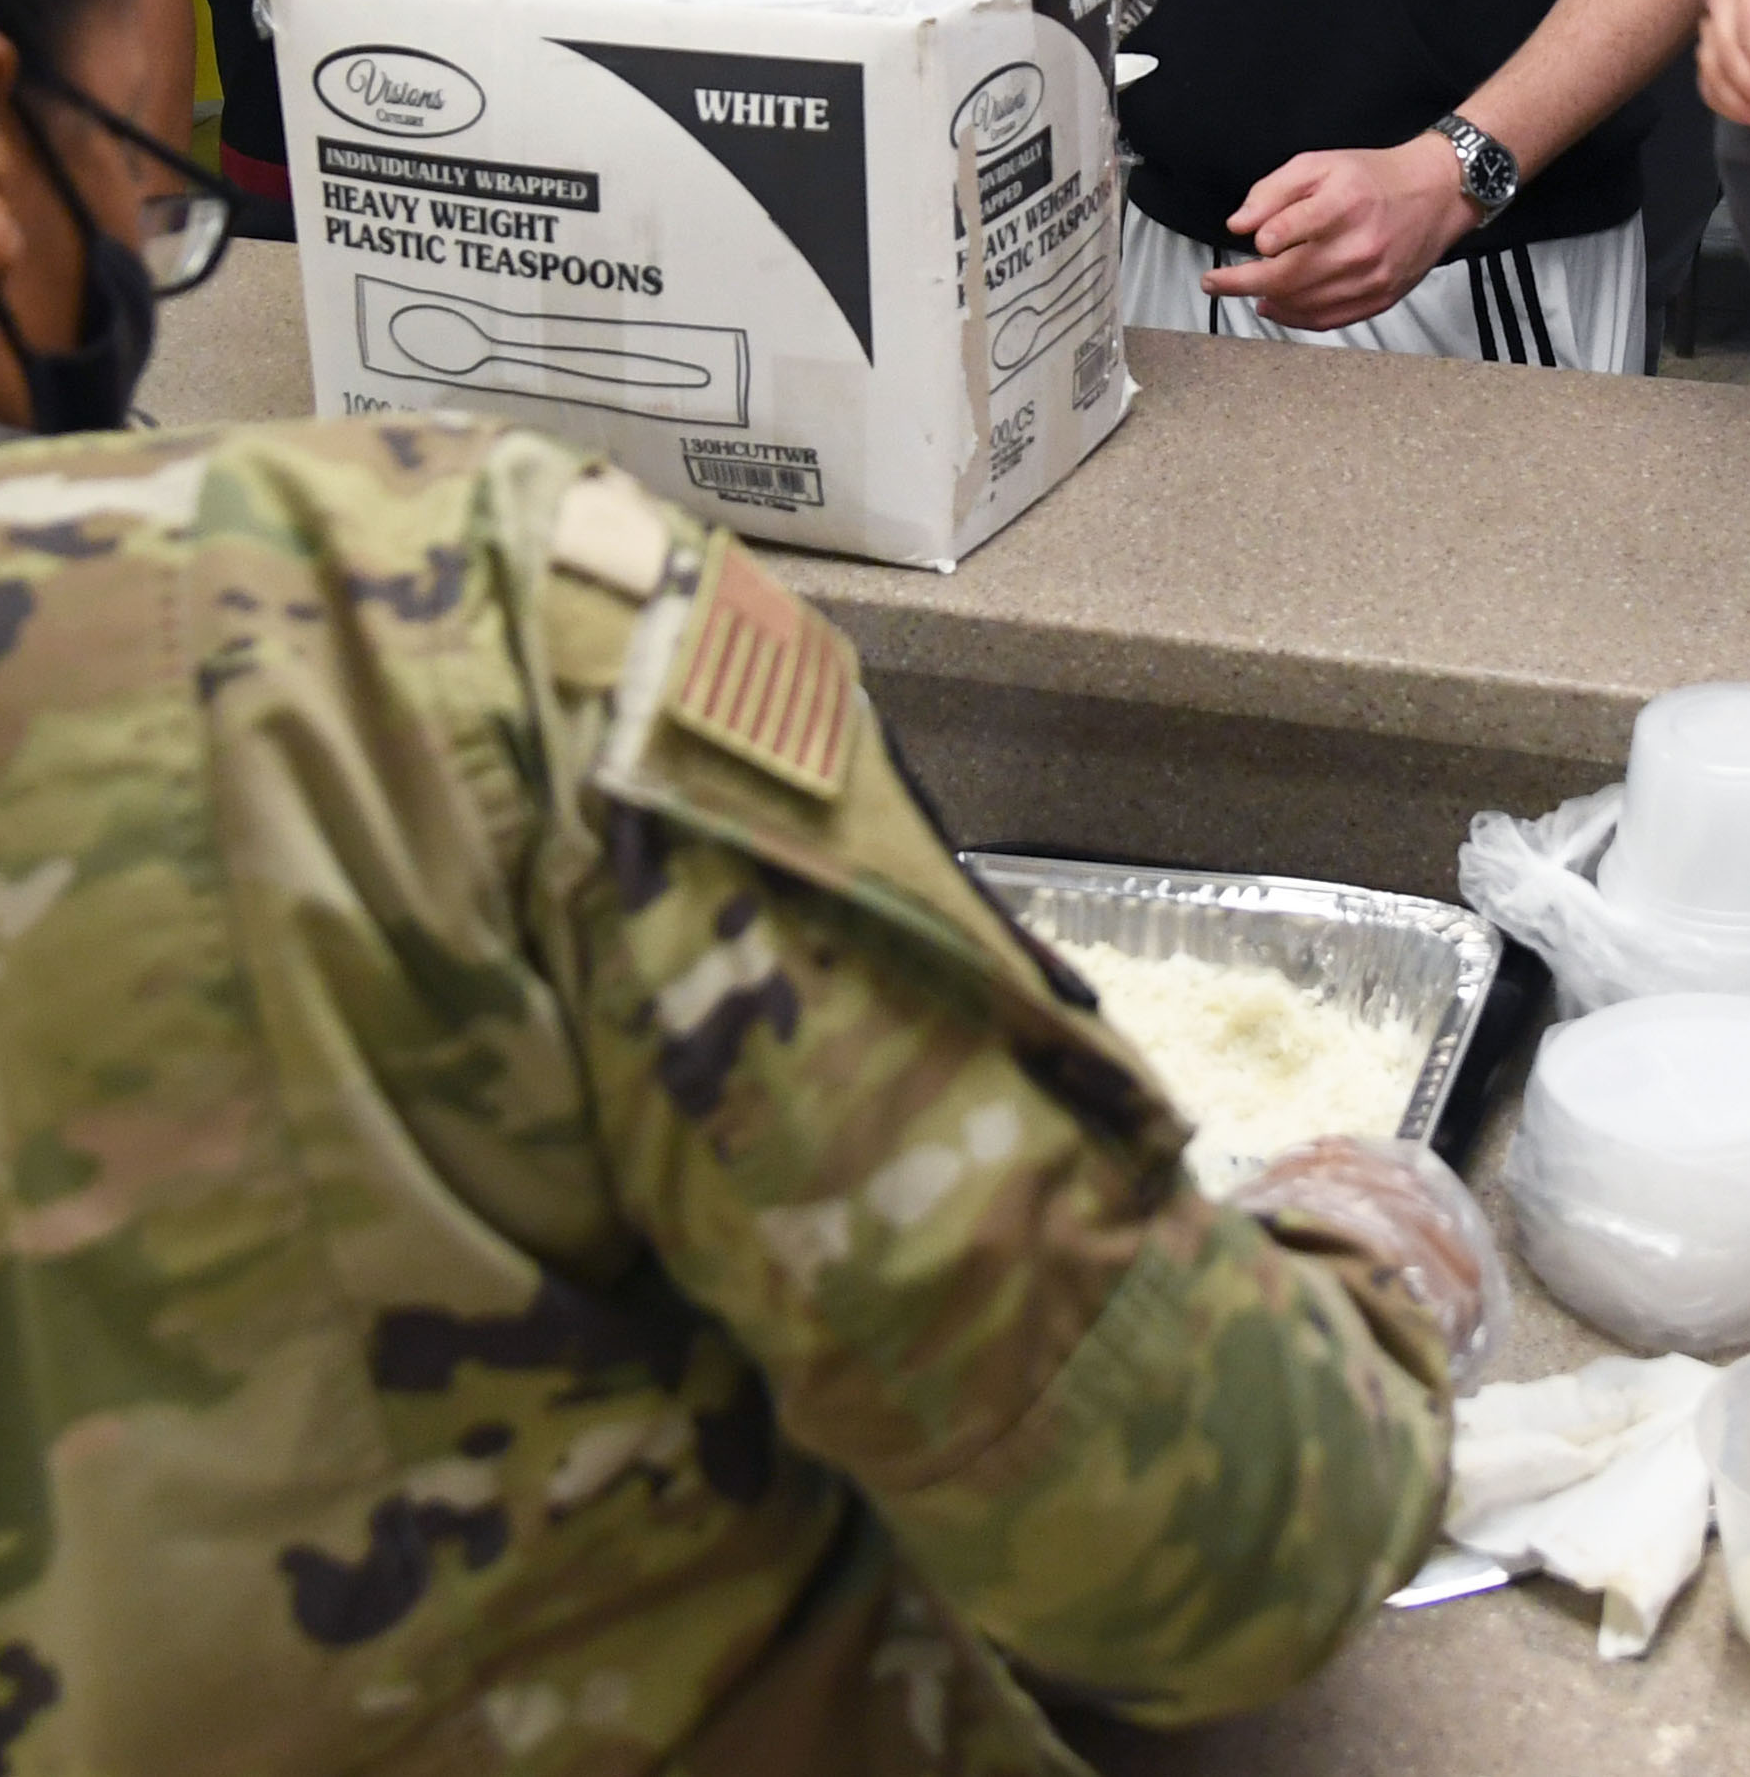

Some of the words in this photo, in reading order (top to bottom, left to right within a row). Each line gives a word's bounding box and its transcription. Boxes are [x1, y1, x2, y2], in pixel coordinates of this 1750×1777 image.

[346, 58, 446, 111] Visions
[694, 88, 831, 132] WHITE
[325, 147, 469, 187] INDIVIDUALLY
[474, 169, 588, 201] WRAPPED
[1025, 169, 1082, 233] WEIGHT
[322, 180, 420, 224] HEAVY
[429, 198, 560, 244] WEIGHT
[324, 215, 447, 265] PLASTIC
[454, 240, 665, 297] TEASPOONS
